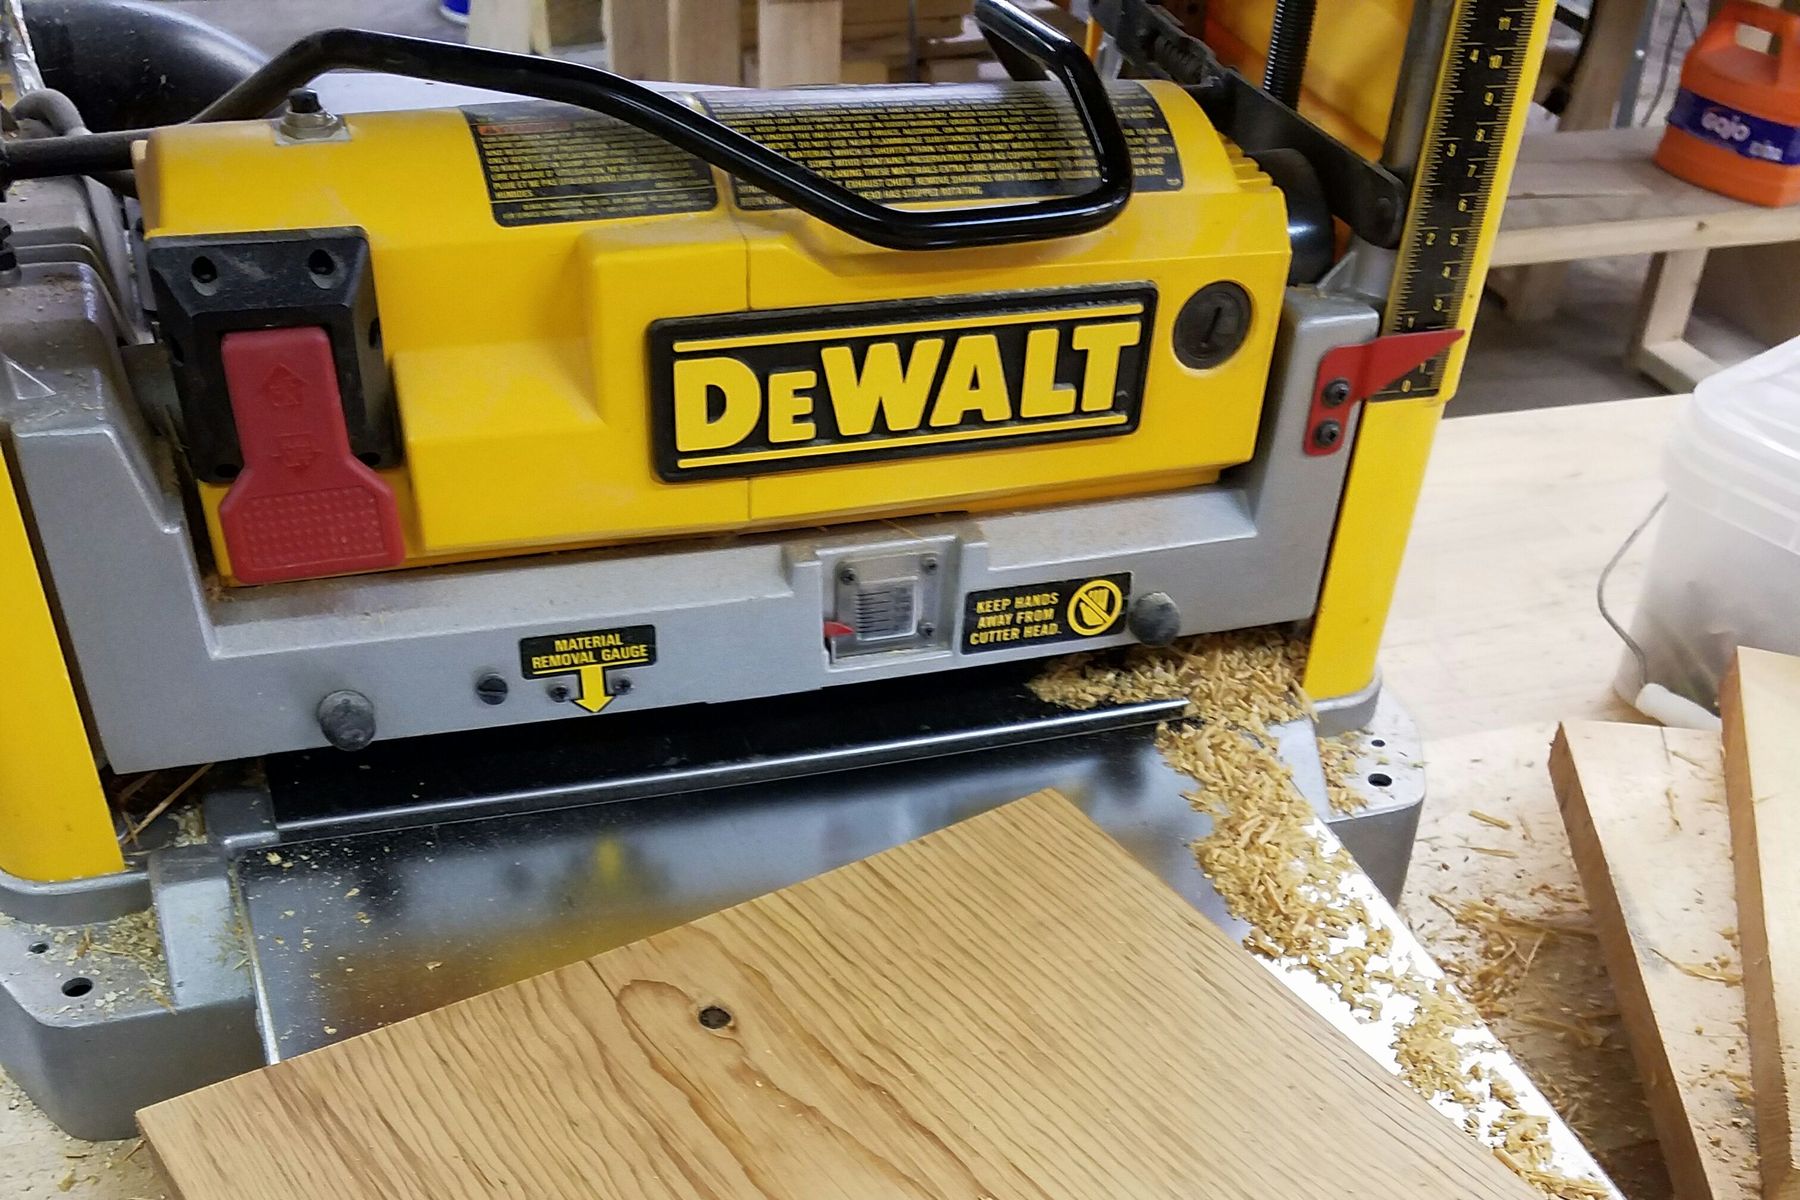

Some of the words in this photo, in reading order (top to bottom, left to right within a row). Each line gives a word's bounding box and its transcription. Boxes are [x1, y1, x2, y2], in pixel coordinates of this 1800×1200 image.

[1483, 92, 1494, 106] 9
[1475, 128, 1486, 142] 8
[1447, 143, 1457, 157] 3
[1467, 164, 1477, 177] 7
[1457, 199, 1468, 212] 6
[1425, 232, 1436, 246] 2
[1450, 232, 1460, 246] 5
[1441, 265, 1451, 279] 4
[1432, 298, 1443, 312] 3
[1401, 379, 1411, 393] 0
[976, 598, 1011, 614] KEEP
[1014, 592, 1060, 609] HANDS
[977, 613, 1013, 629] AWAY
[1016, 608, 1055, 624] FROM
[554, 633, 624, 653] MATERIAL
[970, 627, 1020, 645] CUTTER
[531, 651, 597, 669] REMOVAL
[601, 644, 648, 662] GAUGE
